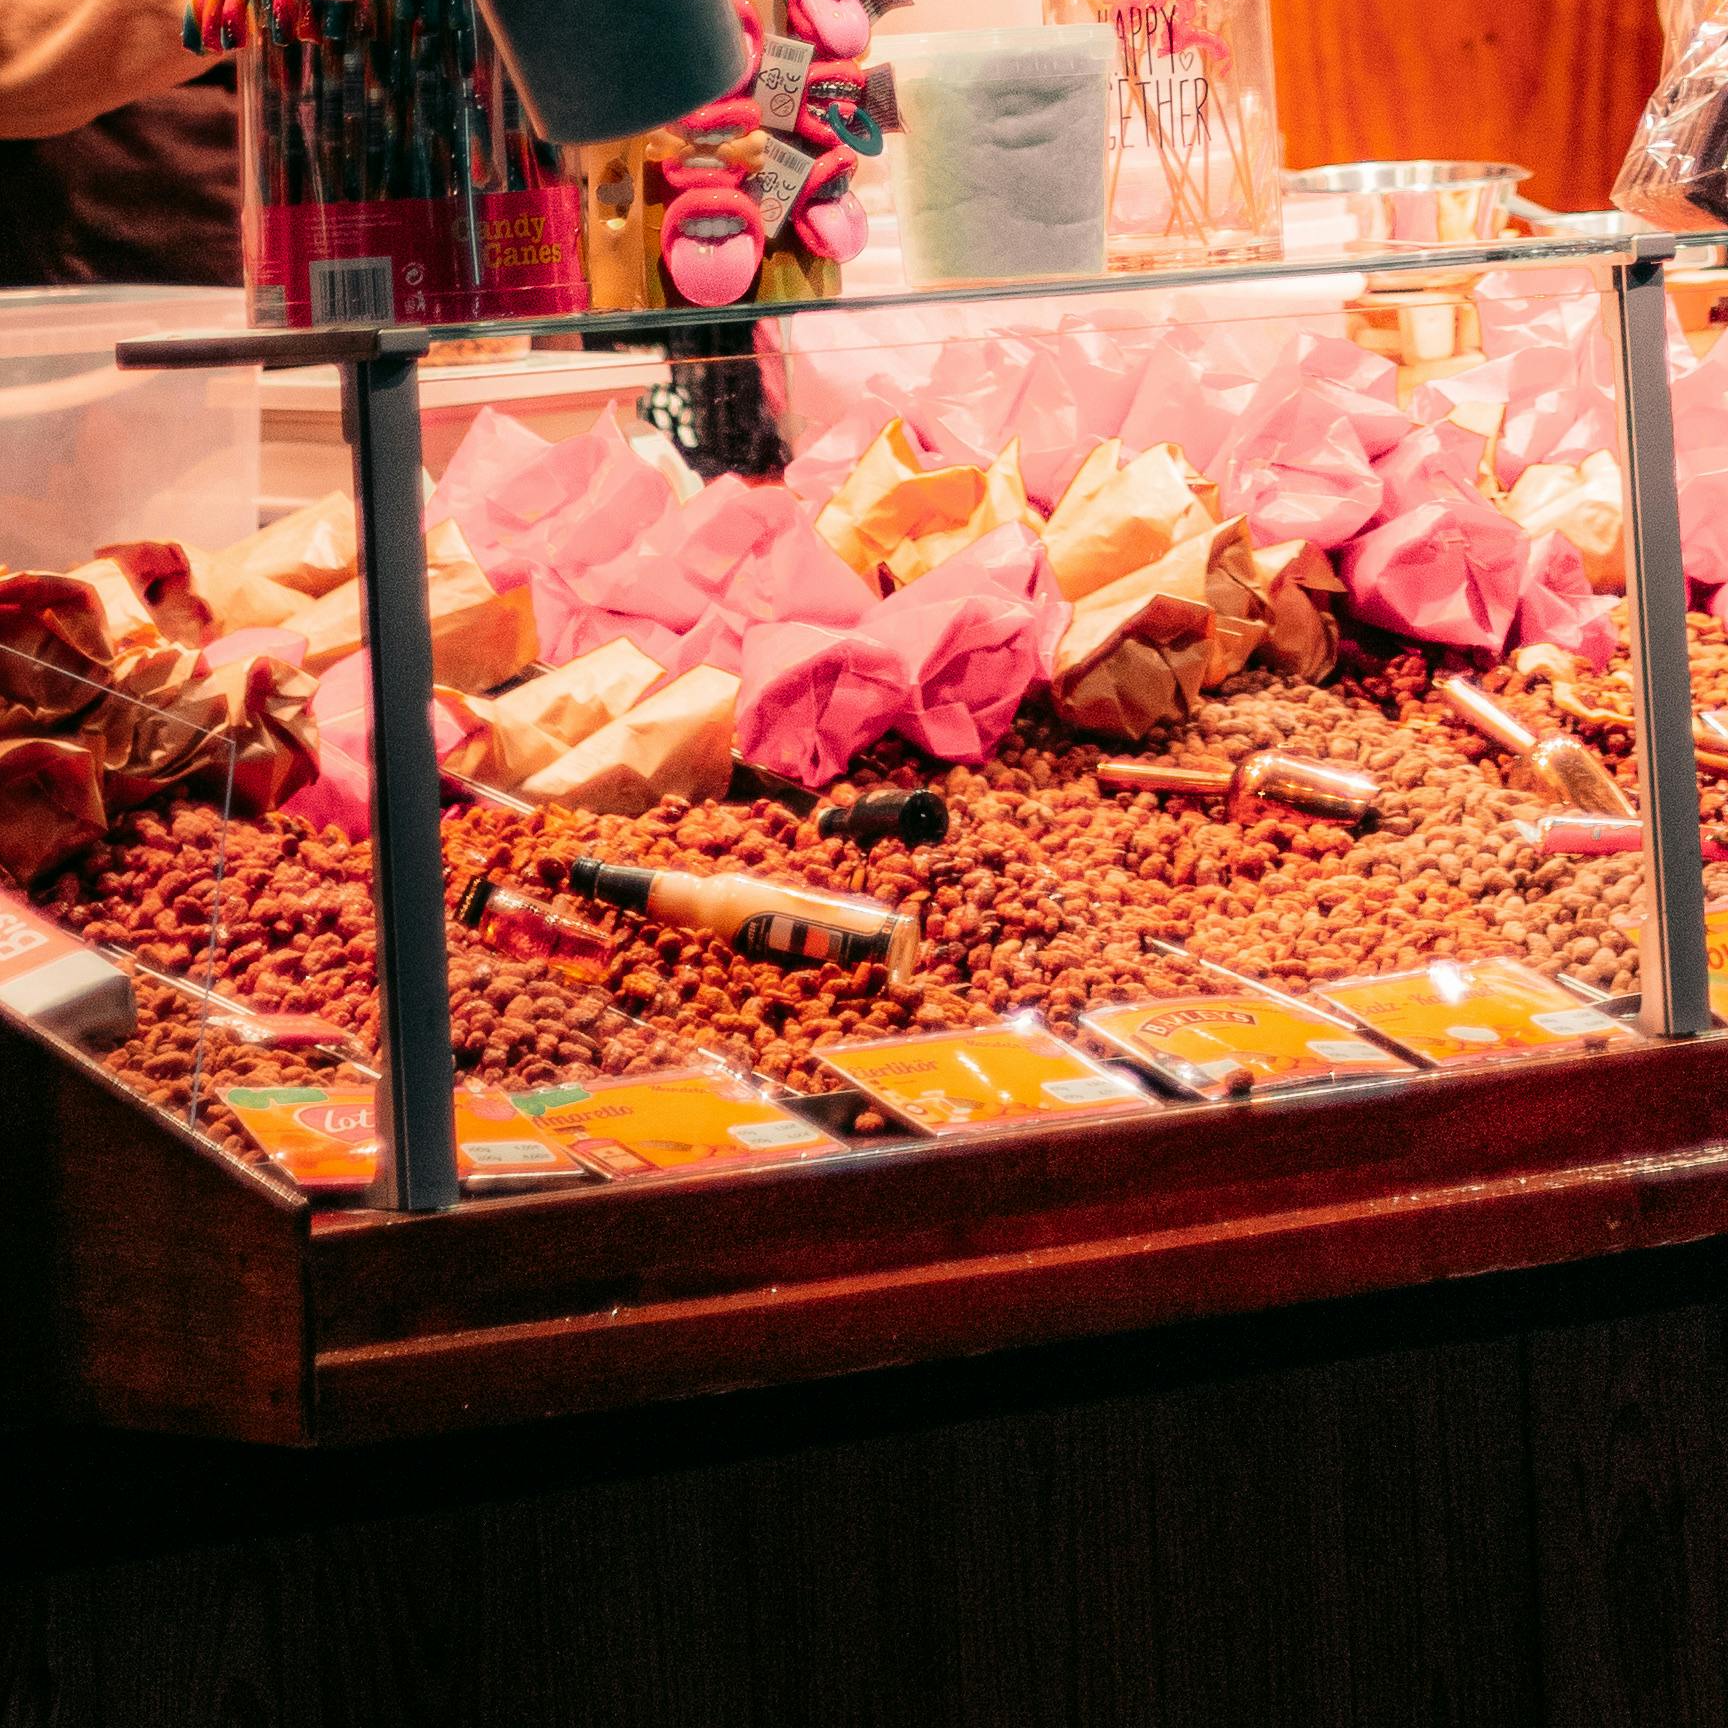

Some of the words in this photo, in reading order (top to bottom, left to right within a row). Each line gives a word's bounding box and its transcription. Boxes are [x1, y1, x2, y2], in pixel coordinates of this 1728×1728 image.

[1108, 77, 1212, 150] ETHER
[452, 211, 547, 243] Candy
[483, 241, 563, 269] Canes
